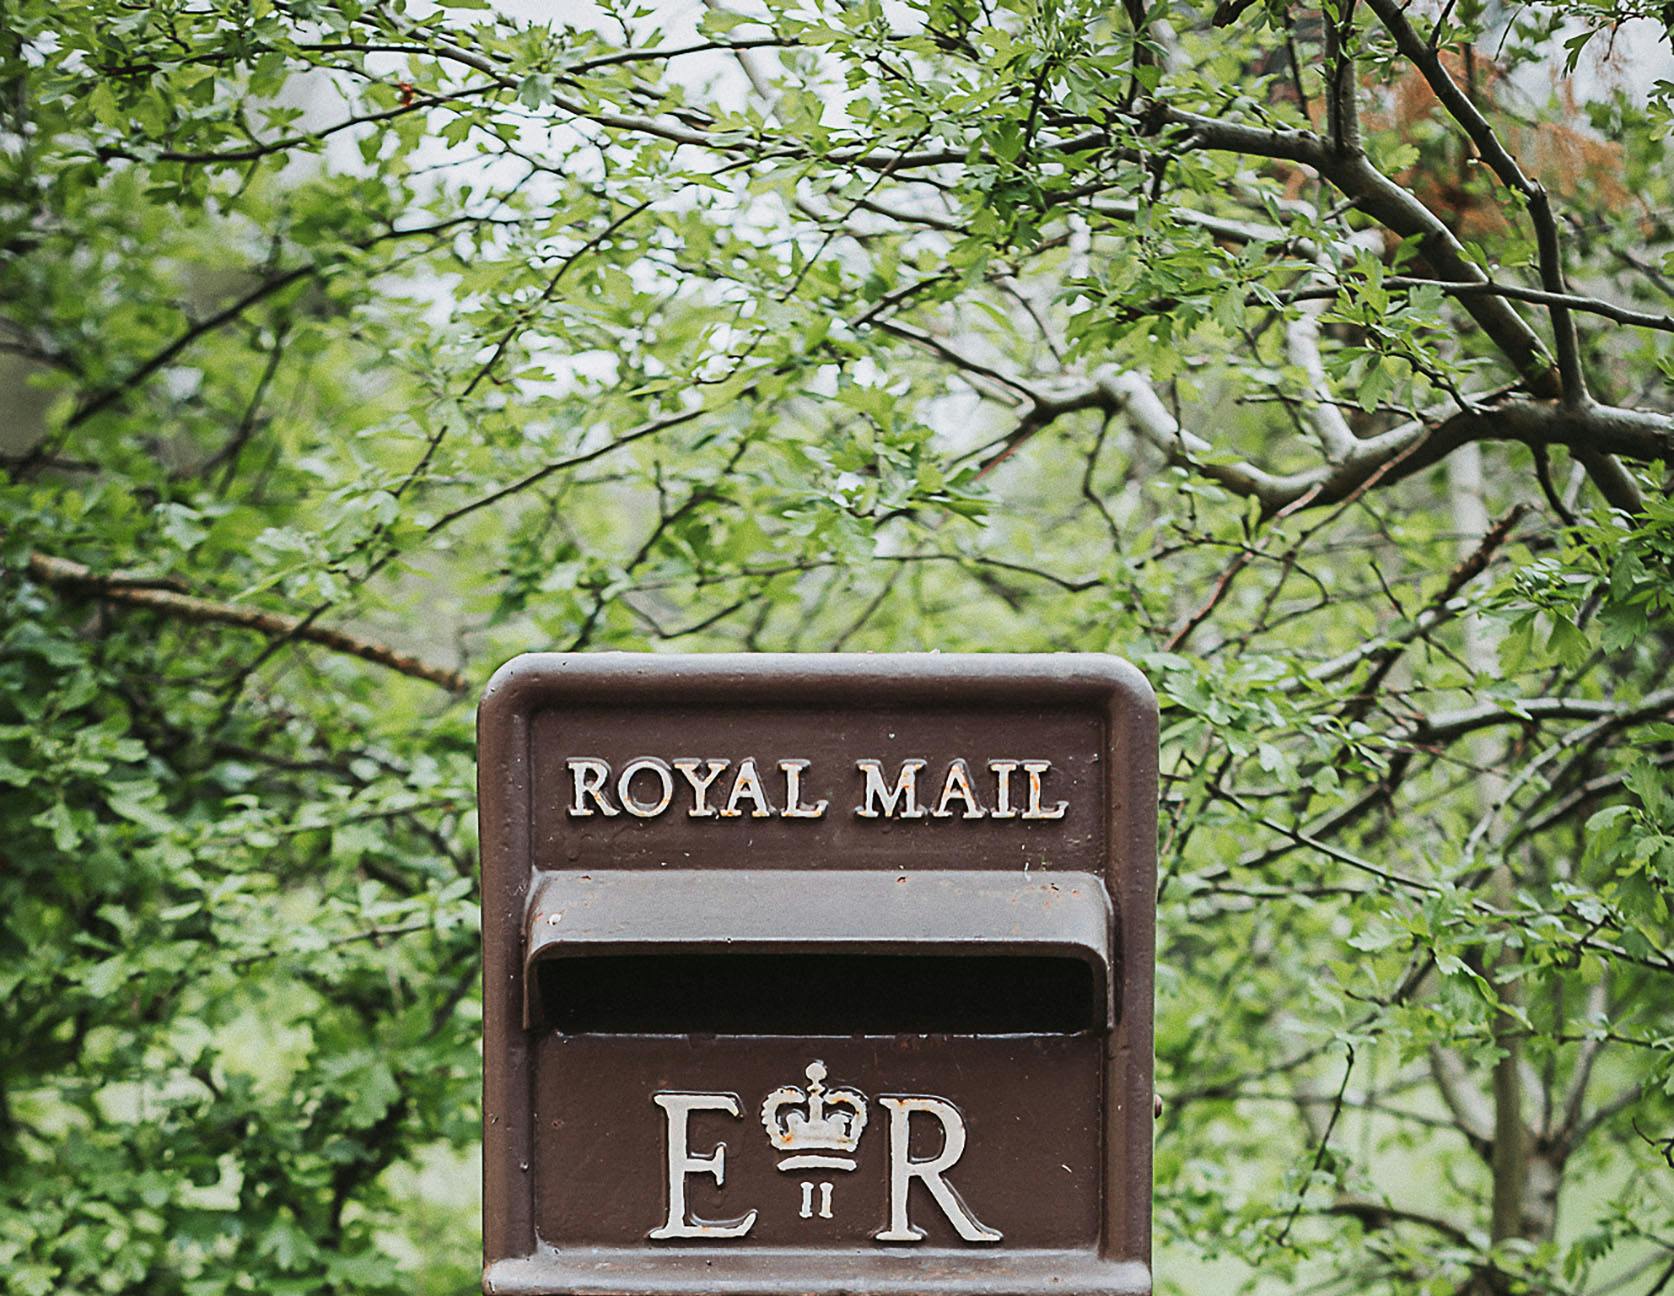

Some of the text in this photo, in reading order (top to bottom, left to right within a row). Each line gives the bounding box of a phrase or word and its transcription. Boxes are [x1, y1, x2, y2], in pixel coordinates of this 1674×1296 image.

[566, 757, 1069, 819] ROYAL MAIL
[649, 1090, 1004, 1242] E R
[798, 1180, 834, 1219] II
